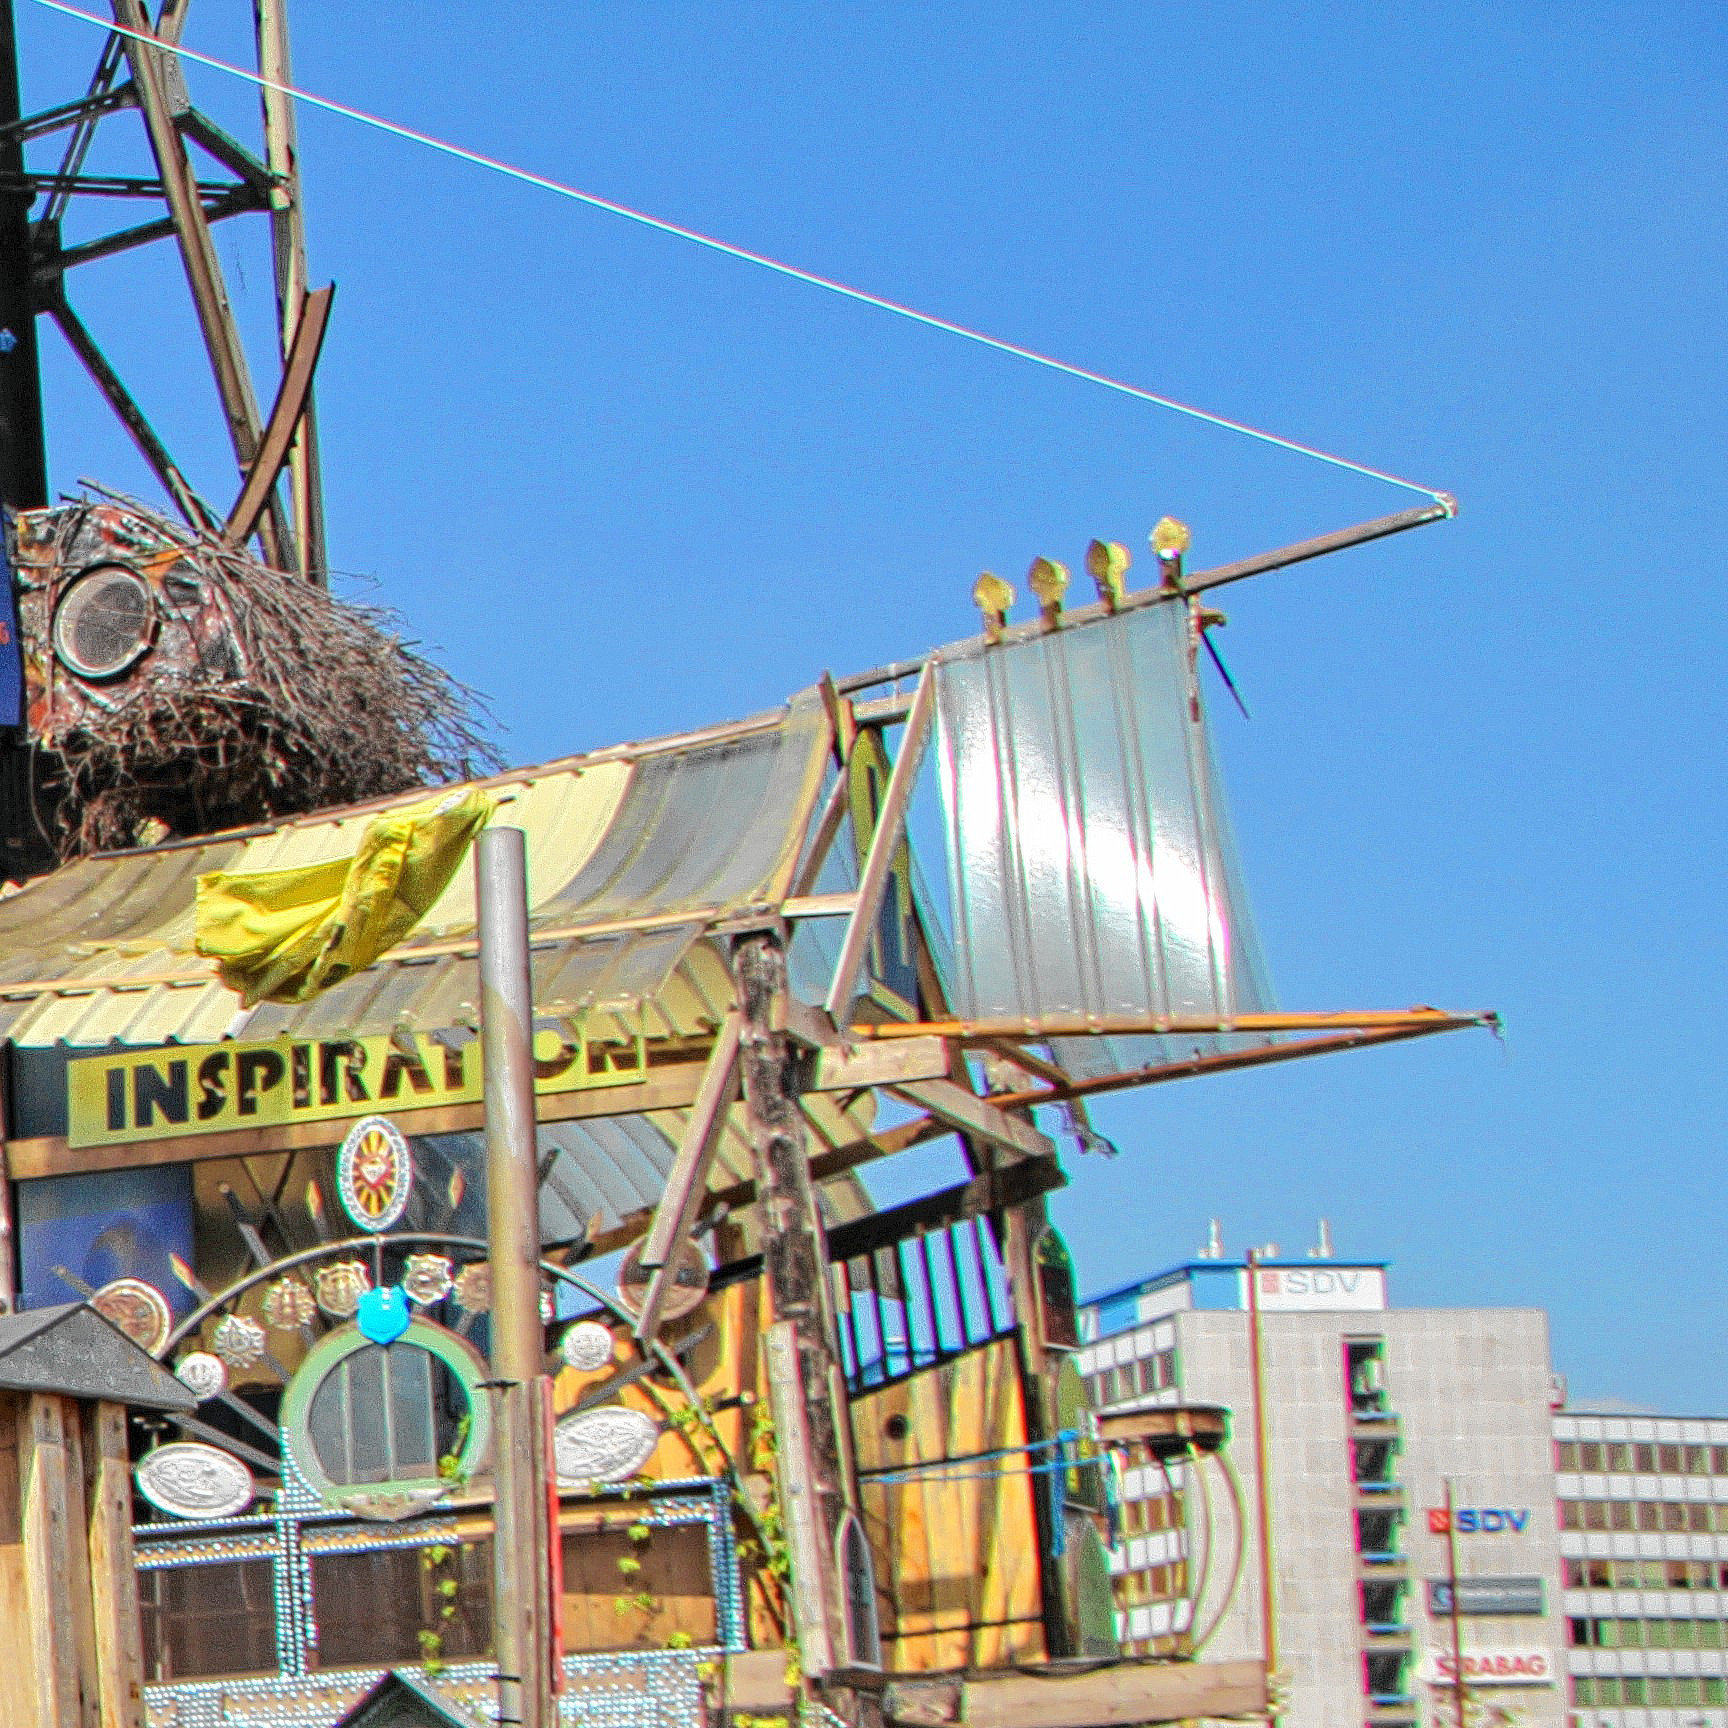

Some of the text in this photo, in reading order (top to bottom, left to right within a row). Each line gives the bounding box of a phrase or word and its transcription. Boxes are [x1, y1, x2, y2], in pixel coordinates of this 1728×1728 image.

[105, 1024, 638, 1131] INSPIRATON
[1284, 1271, 1362, 1294] SDV
[1456, 1509, 1532, 1533] SDV
[1434, 1654, 1547, 1677] SRABAG
